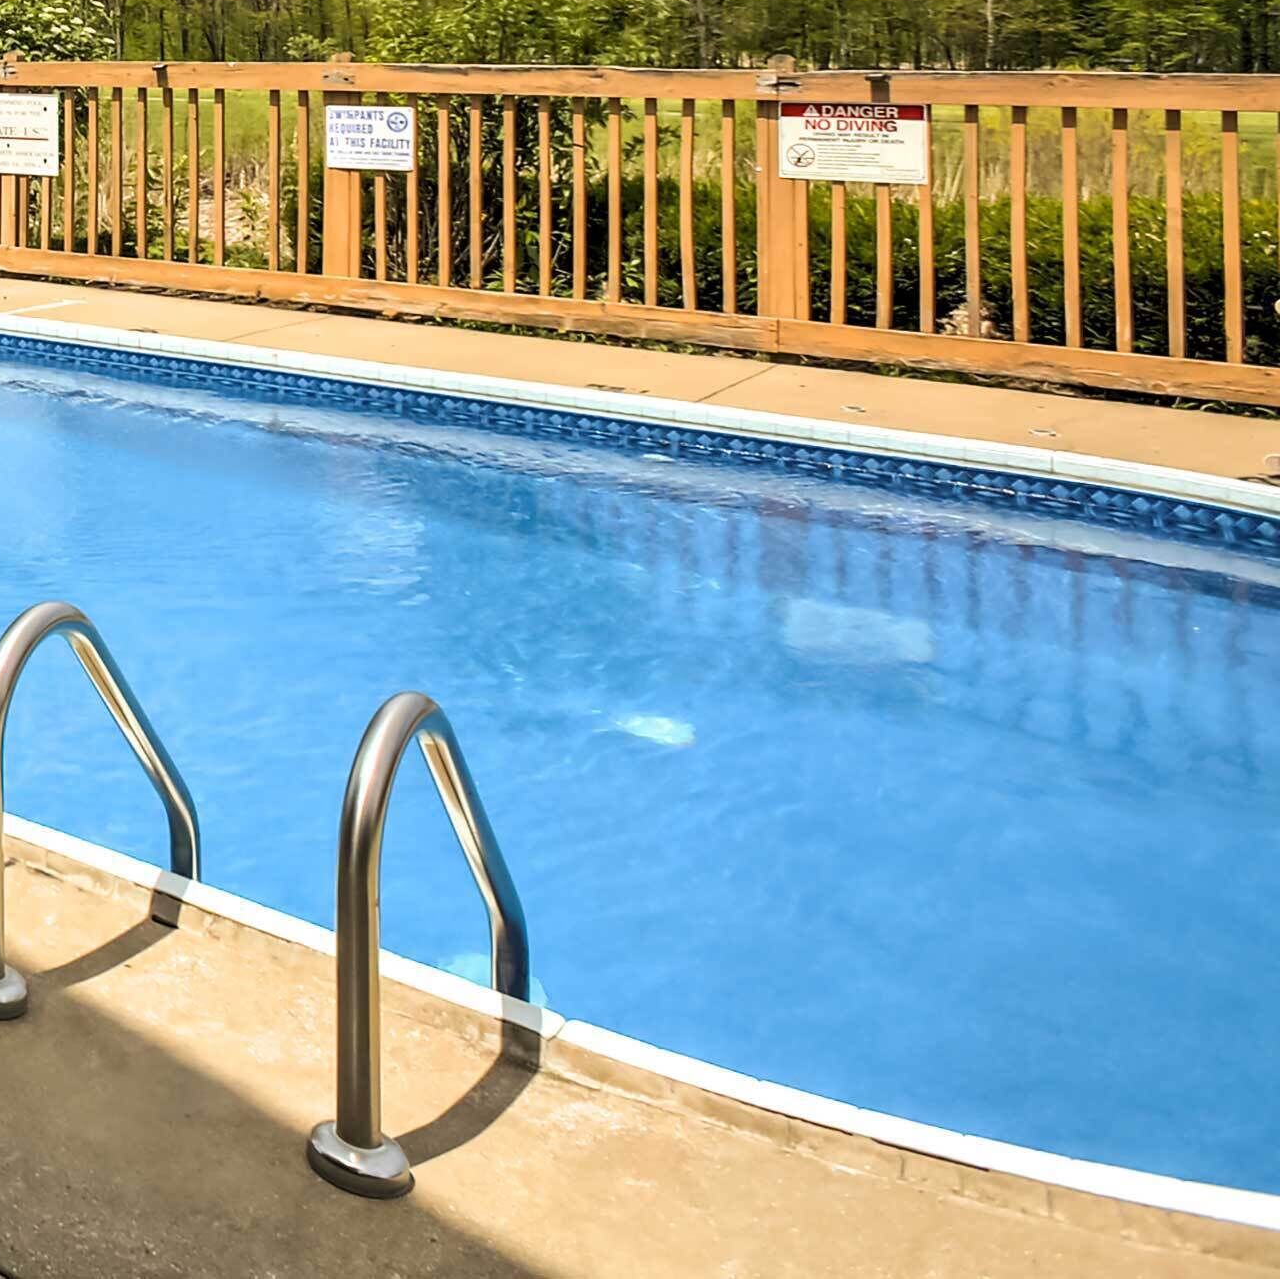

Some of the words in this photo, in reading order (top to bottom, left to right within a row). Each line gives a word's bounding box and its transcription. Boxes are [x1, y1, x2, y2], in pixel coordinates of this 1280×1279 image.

[821, 105, 899, 118] DANGER
[804, 119, 831, 131] NO
[836, 119, 898, 132] DIVING
[370, 138, 410, 149] FACILITY
